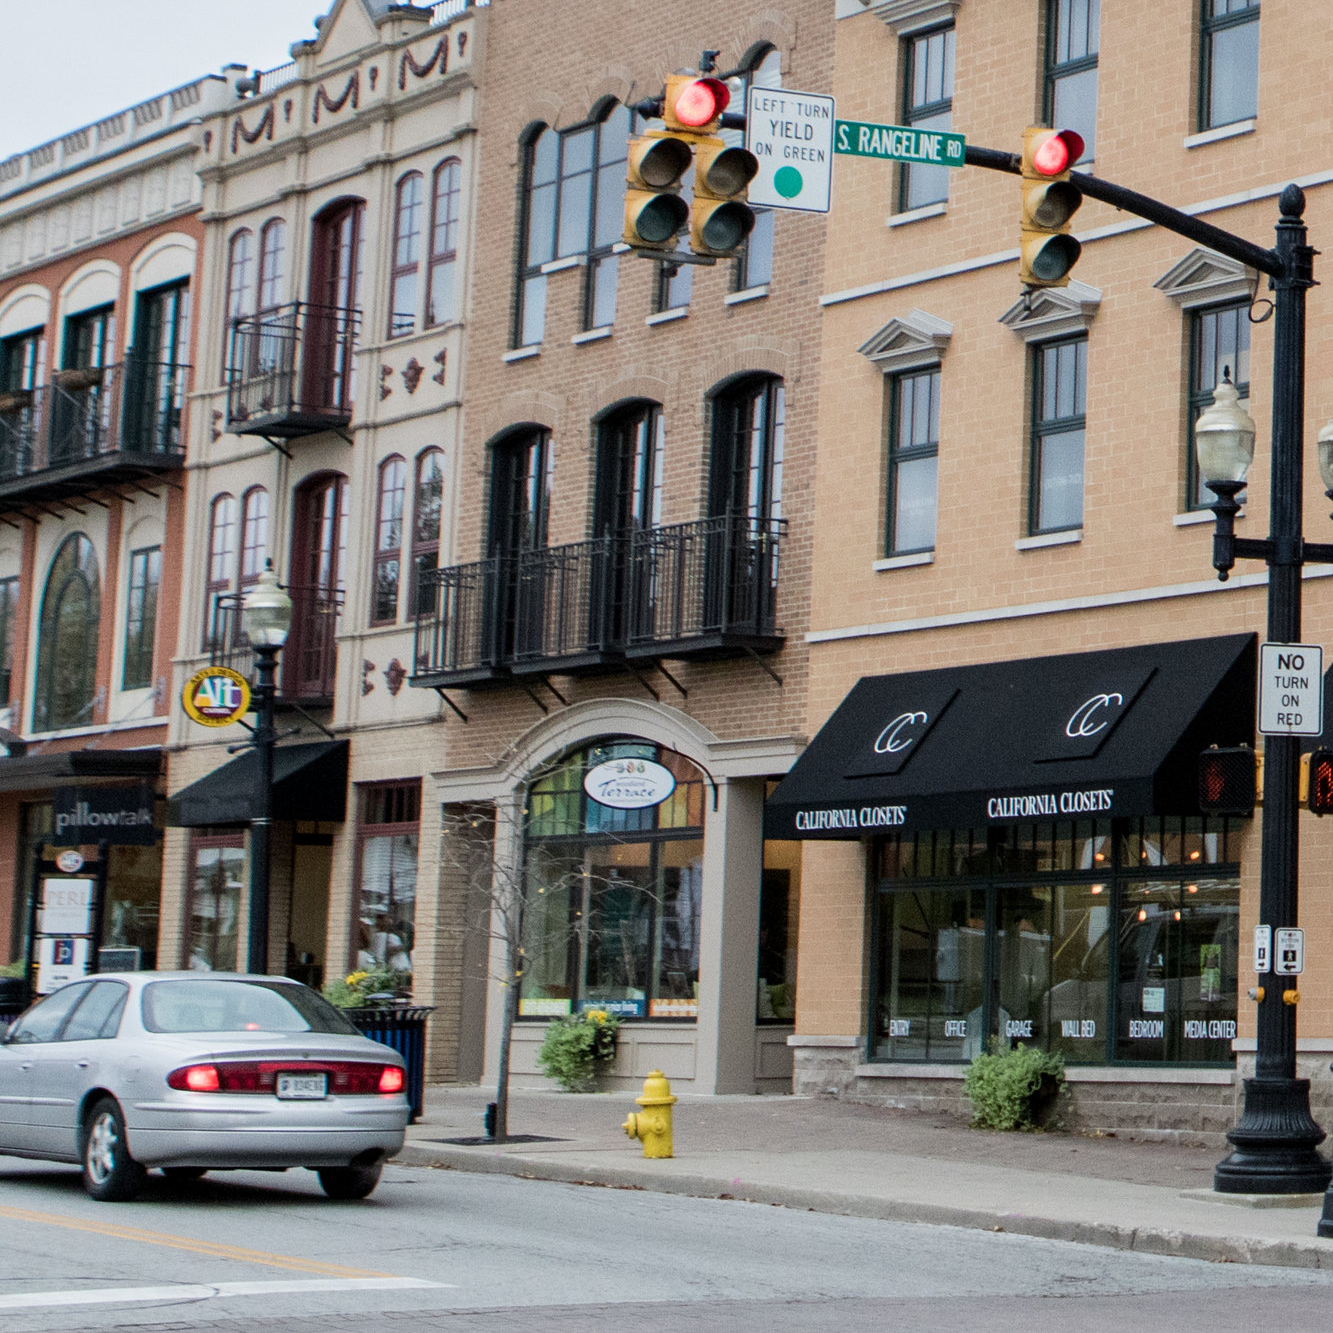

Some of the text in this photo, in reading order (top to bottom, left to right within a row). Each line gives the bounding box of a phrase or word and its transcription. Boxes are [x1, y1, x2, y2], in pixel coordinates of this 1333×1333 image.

[754, 97, 830, 119] LEFT TURN
[769, 119, 814, 141] YIELD
[837, 123, 962, 162] S. RANGELINE RD
[755, 141, 825, 164] ON GREEN
[1278, 653, 1305, 671] NO
[1274, 675, 1309, 689] TURN
[1281, 694, 1300, 707] ON
[1276, 712, 1303, 726] RED
[988, 793, 1058, 819] CALIFORNIA
[56, 801, 153, 835] pillowtalk
[796, 808, 858, 830] CALIFORNIA
[889, 1020, 910, 1037] ENTRY
[944, 1020, 967, 1037] OFFICE
[1005, 1020, 1033, 1038] GARAGE
[1061, 1020, 1096, 1038] WALL BED
[1129, 1020, 1164, 1039] BEDROOM
[1184, 1020, 1237, 1039] MEDIA CENTER
